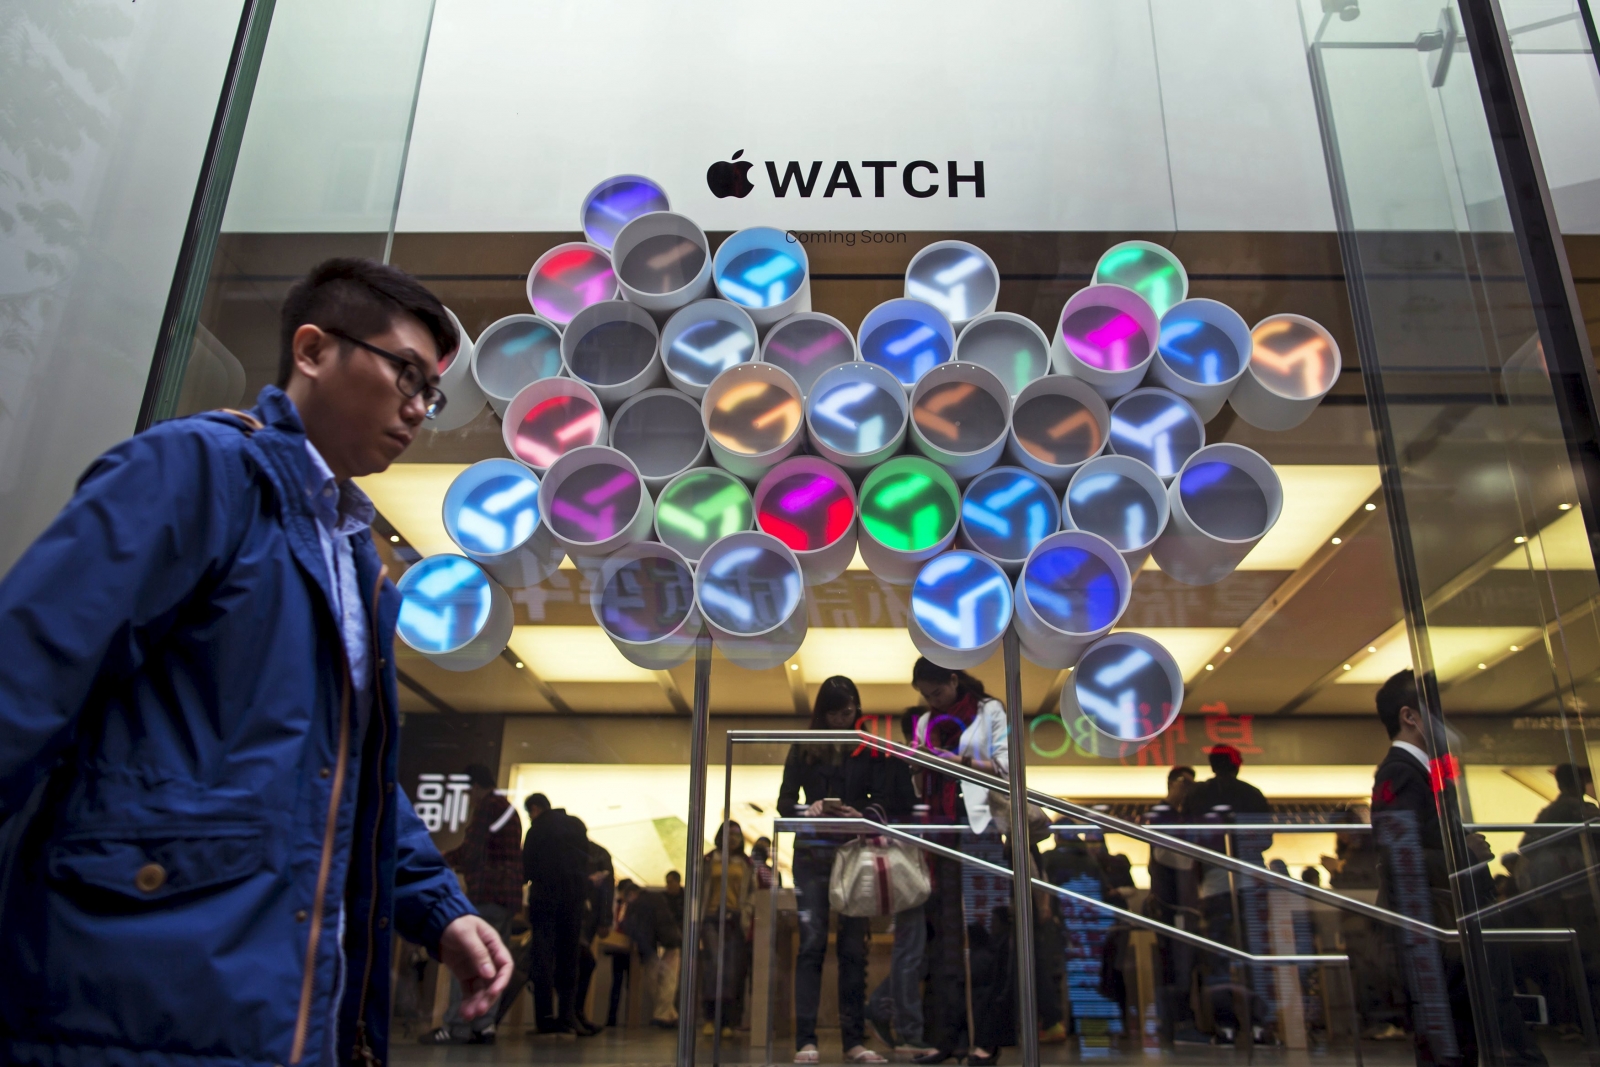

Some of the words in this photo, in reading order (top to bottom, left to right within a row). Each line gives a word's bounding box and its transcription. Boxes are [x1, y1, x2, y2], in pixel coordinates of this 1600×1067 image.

[764, 160, 986, 199] WATCH
[785, 230, 856, 246] Coming
[861, 229, 907, 243] Soon
